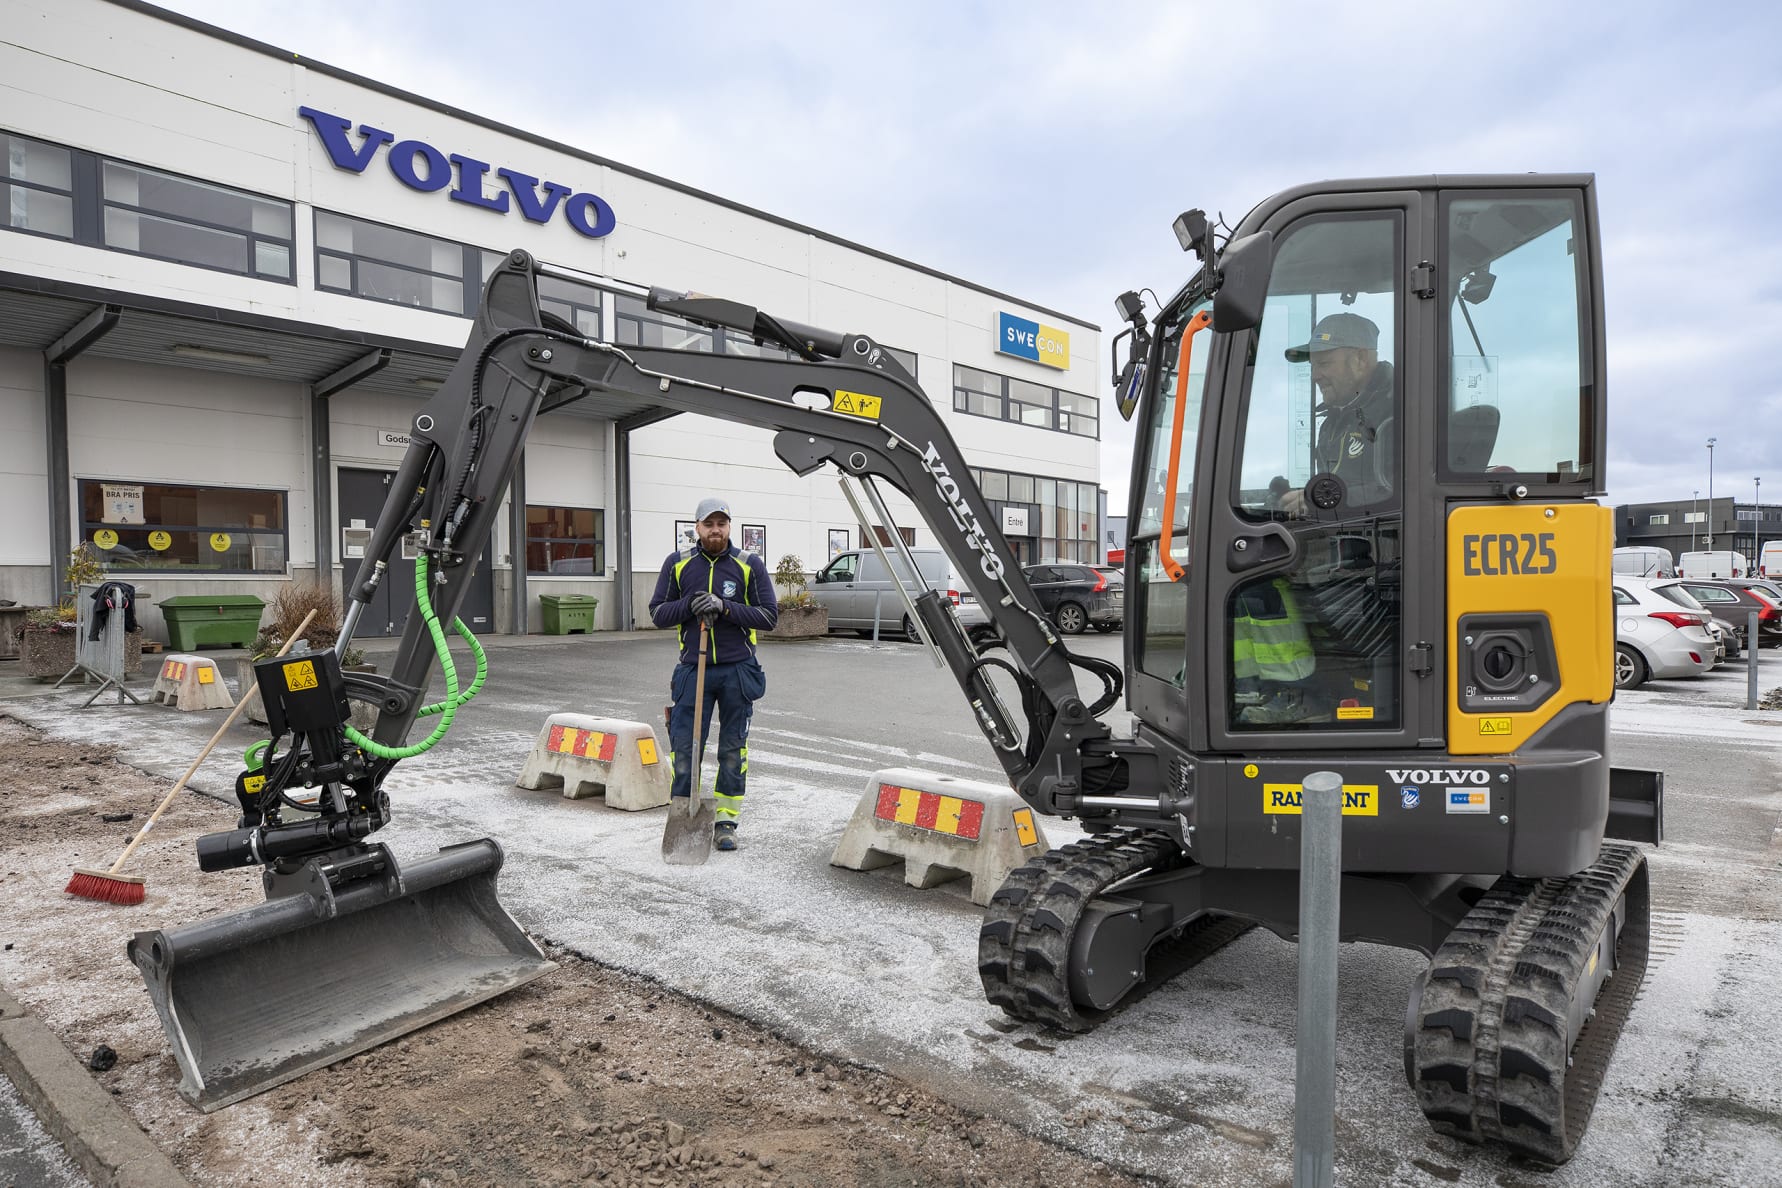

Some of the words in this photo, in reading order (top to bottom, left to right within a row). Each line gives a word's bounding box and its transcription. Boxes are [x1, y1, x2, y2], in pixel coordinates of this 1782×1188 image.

[297, 105, 616, 238] VOLVO
[1007, 327, 1063, 356] SWECON
[386, 434, 411, 443] Gods
[921, 441, 1004, 580] VOLVO
[1008, 516, 1023, 526] Entré
[1463, 533, 1557, 576] ECR25
[1385, 769, 1490, 784] VOLVO
